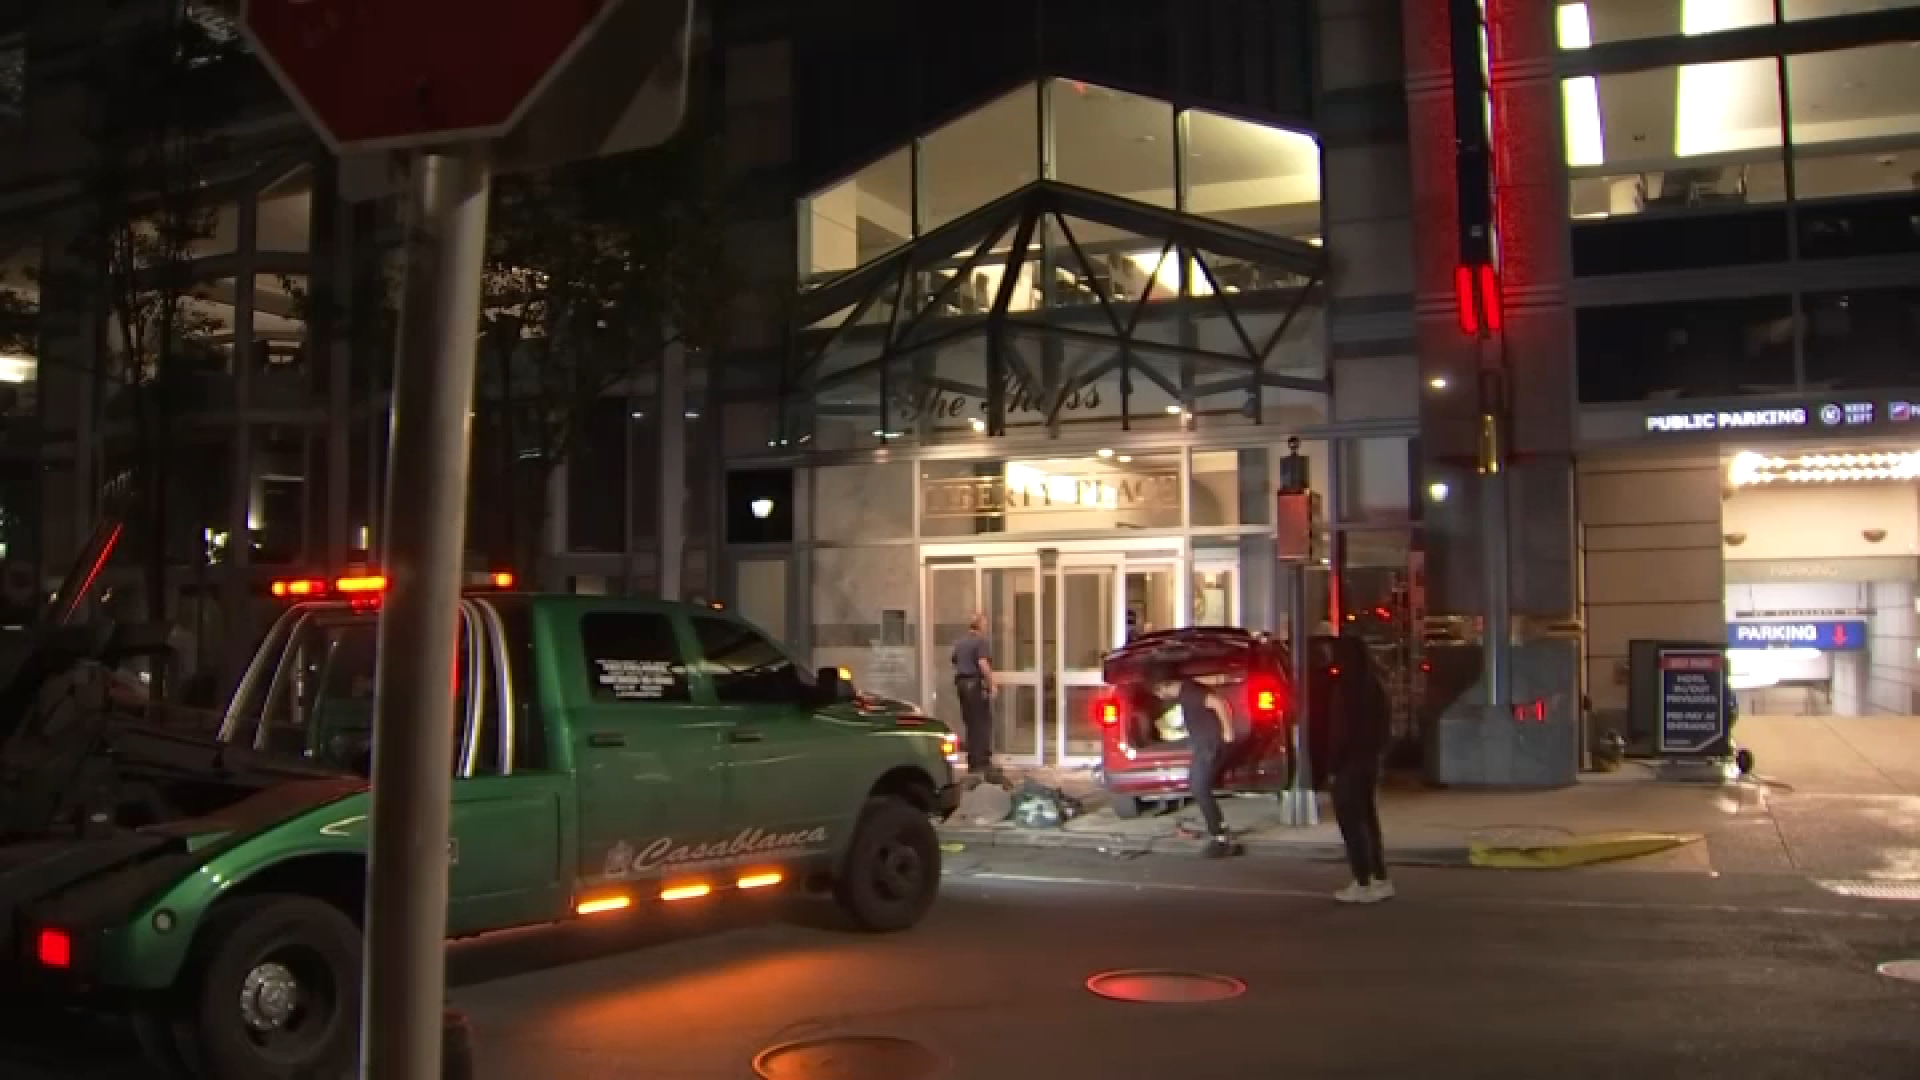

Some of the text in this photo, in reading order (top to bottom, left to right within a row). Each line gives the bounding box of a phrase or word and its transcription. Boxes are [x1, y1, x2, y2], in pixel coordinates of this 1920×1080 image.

[1845, 402, 1873, 412] KEEP
[1646, 408, 1806, 431] PUBLIC PARKING
[1737, 624, 1818, 641] PARKING
[632, 826, 826, 871] Casablanca
